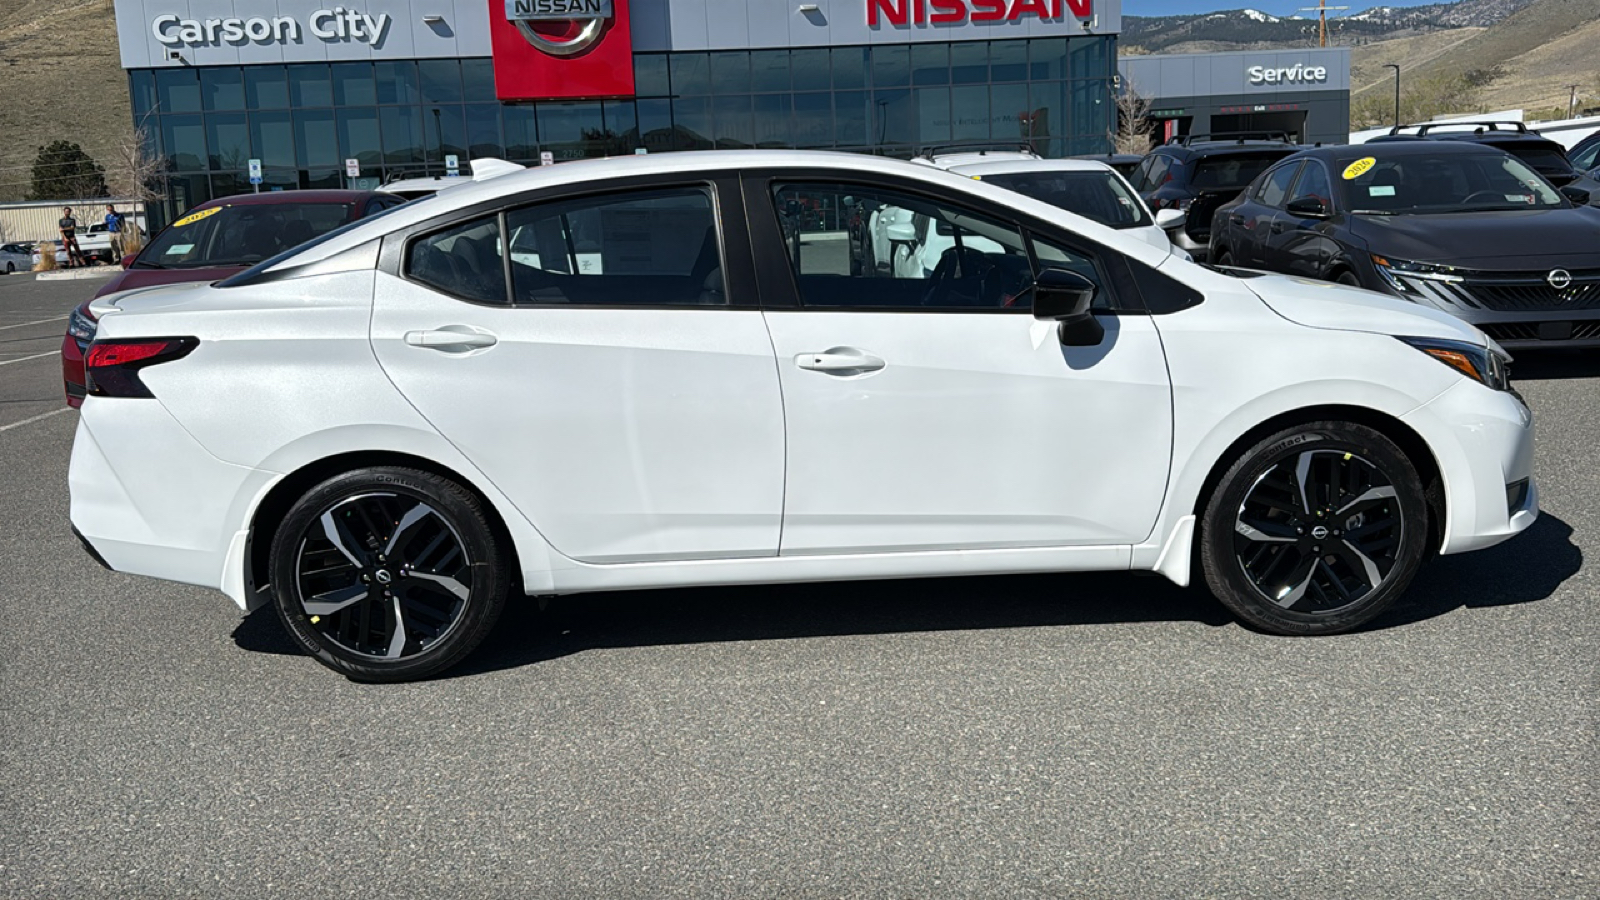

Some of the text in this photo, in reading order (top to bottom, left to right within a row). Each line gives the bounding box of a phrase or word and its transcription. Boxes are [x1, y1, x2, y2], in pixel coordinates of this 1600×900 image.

[515, 0, 600, 14] NISSAN
[867, 0, 1092, 26] NISSAN
[152, 7, 387, 45] Carson City
[1249, 63, 1326, 82] Service
[1347, 160, 1371, 175] 2026
